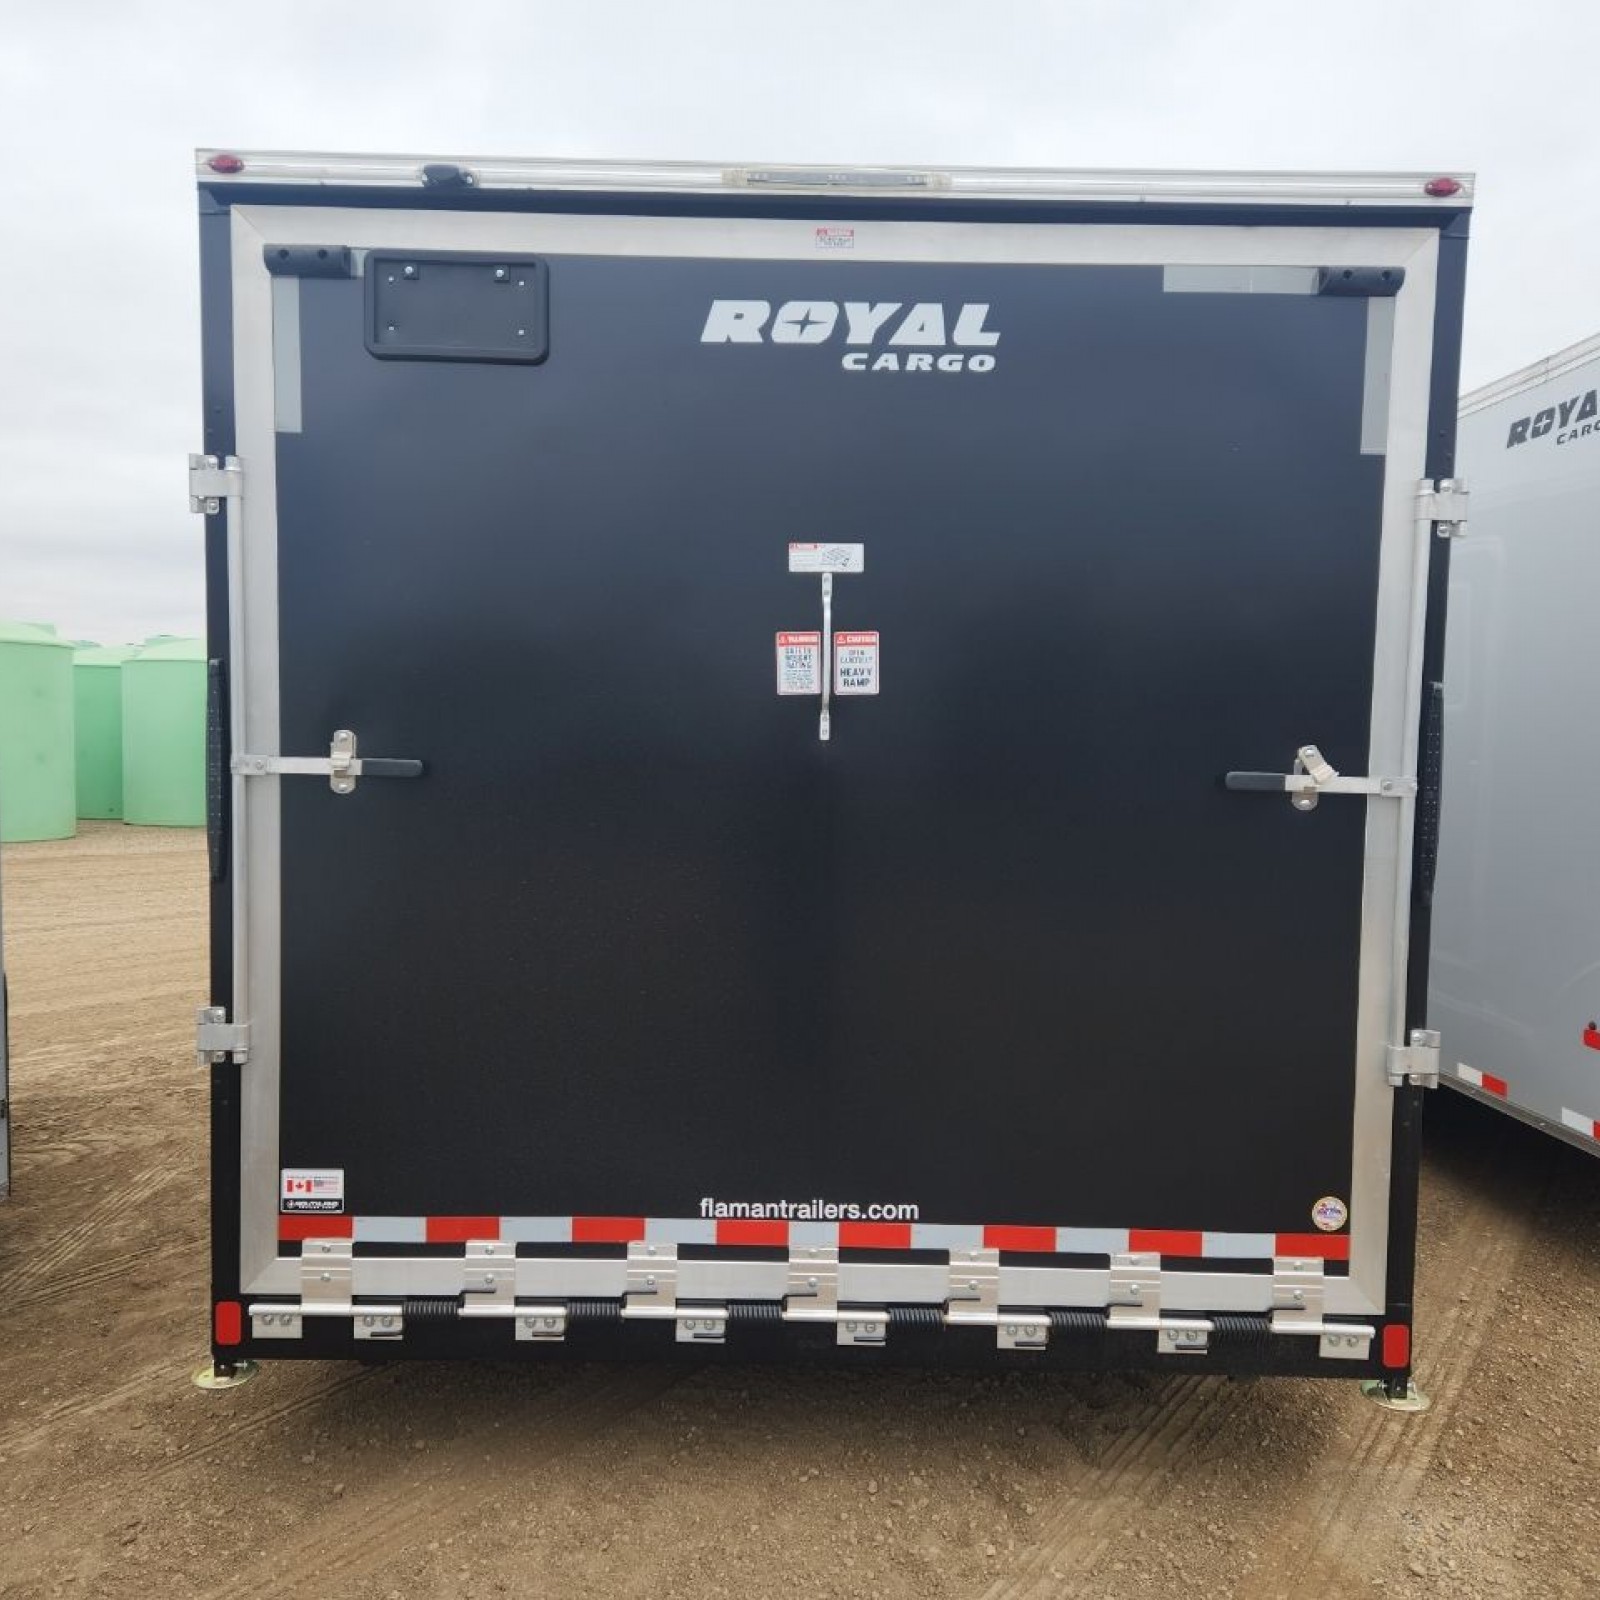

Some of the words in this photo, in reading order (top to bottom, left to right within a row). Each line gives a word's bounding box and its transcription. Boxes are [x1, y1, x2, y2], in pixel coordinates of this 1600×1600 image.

[700, 299, 1001, 346] ROYAL
[841, 352, 996, 372] CARGO
[840, 667, 873, 676] HEAVY
[843, 677, 870, 687] RAMP
[700, 1197, 919, 1220] flamantrailers.com
